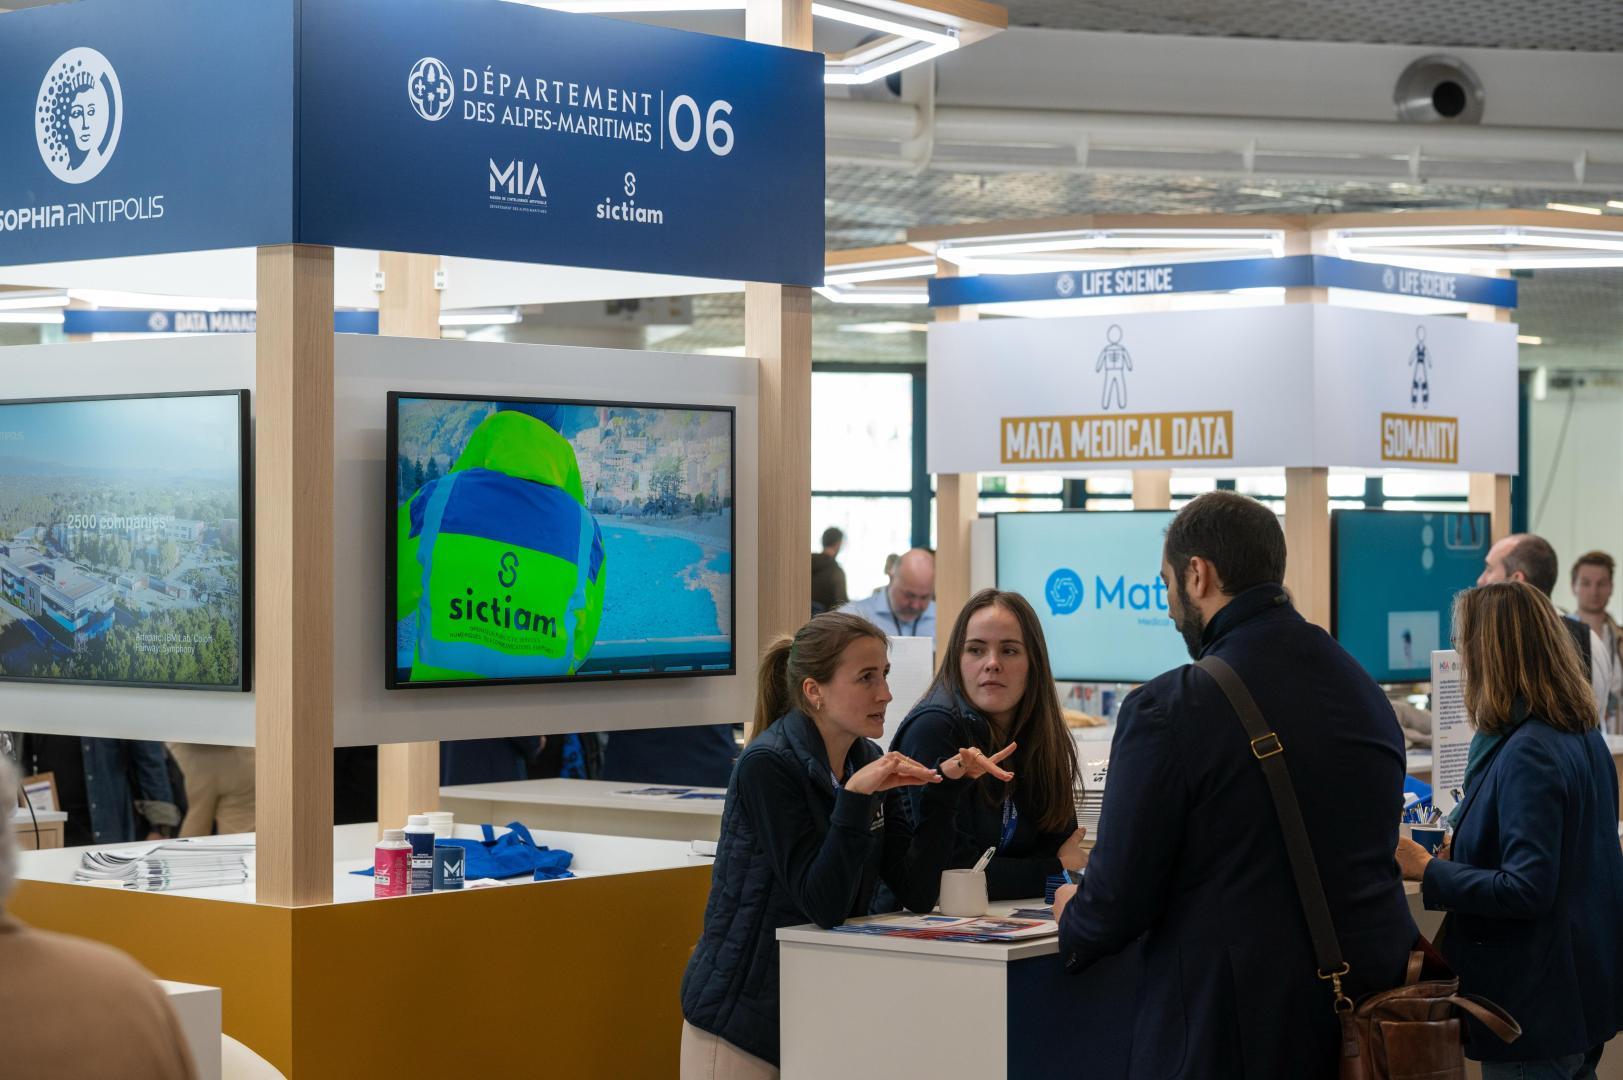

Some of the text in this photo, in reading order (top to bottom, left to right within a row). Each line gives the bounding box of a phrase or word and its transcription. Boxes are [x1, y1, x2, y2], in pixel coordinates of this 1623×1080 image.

[462, 65, 653, 116] DÉPARTEMENT
[463, 100, 652, 143] DES ALPES-MARITIMES
[668, 94, 735, 156] 06
[489, 157, 547, 198] MIA
[67, 195, 165, 226] ANTIPOLIS
[596, 197, 664, 225] sictiam
[1082, 267, 1173, 296] LIFE SCIENCE
[1399, 269, 1456, 299] LIFE SCIENCE
[175, 311, 208, 332] DATA
[1006, 416, 1229, 460] MATA MEDICAL DATA
[1383, 417, 1457, 459] SOMANITY
[67, 512, 166, 533] 2500 companies
[449, 587, 557, 638] sictiam
